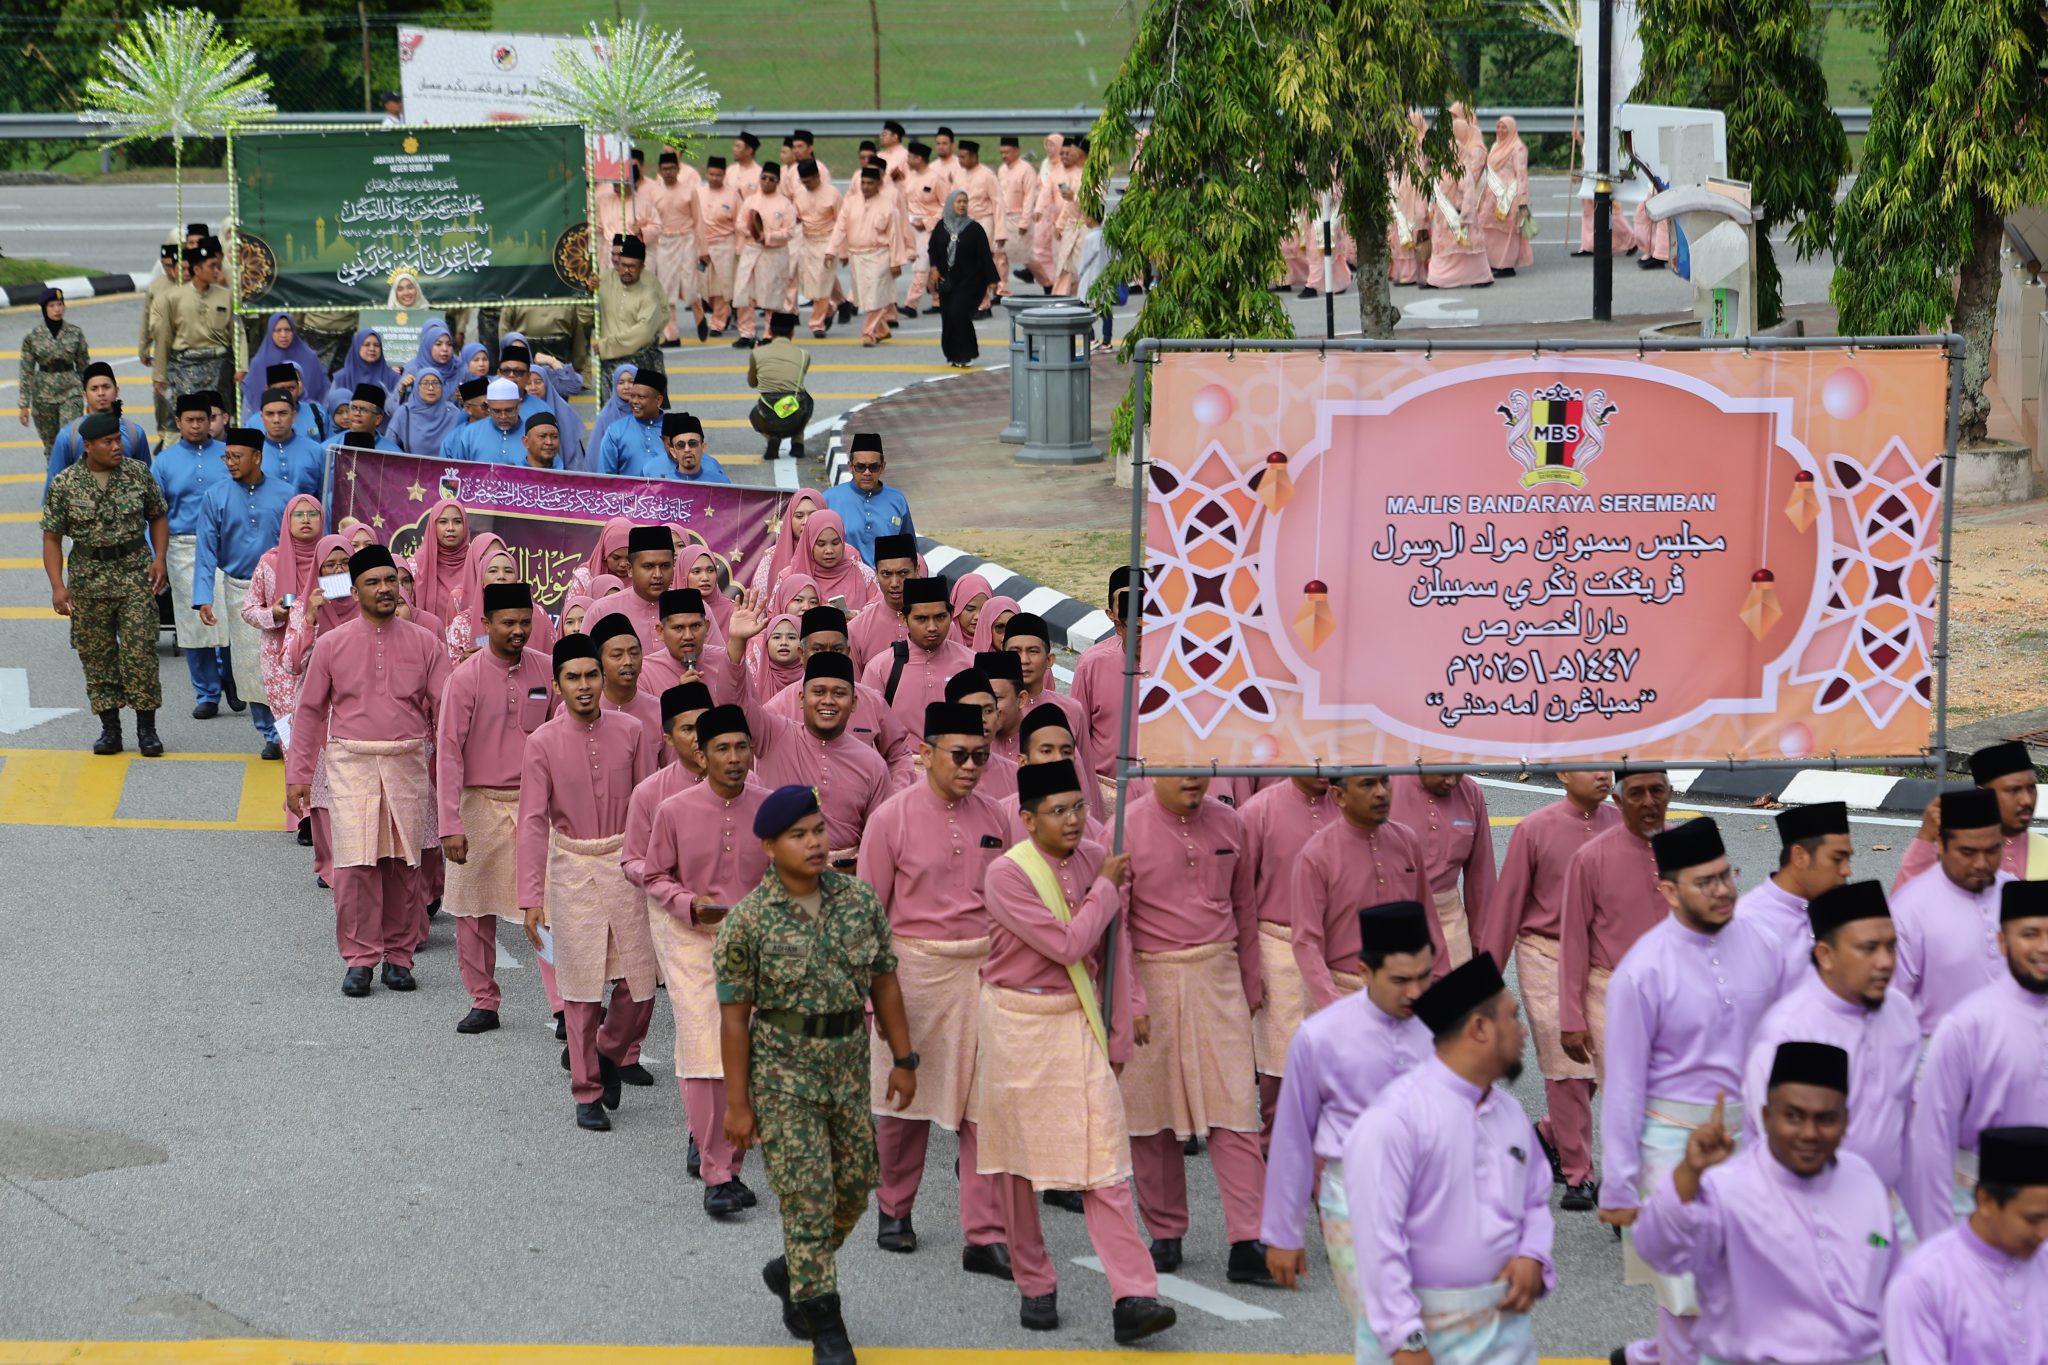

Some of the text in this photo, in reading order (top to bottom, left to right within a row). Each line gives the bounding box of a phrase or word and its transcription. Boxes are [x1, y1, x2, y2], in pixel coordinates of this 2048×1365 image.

[1534, 425, 1578, 441] MBS
[1386, 494, 1716, 514] MAJLIS BANDARAYA SEREMBAN
[1372, 520, 1727, 567] مجليس سمبوتن مولد الرسول
[1409, 566, 1497, 607] سمبيلن
[1501, 690, 1538, 715] امه
